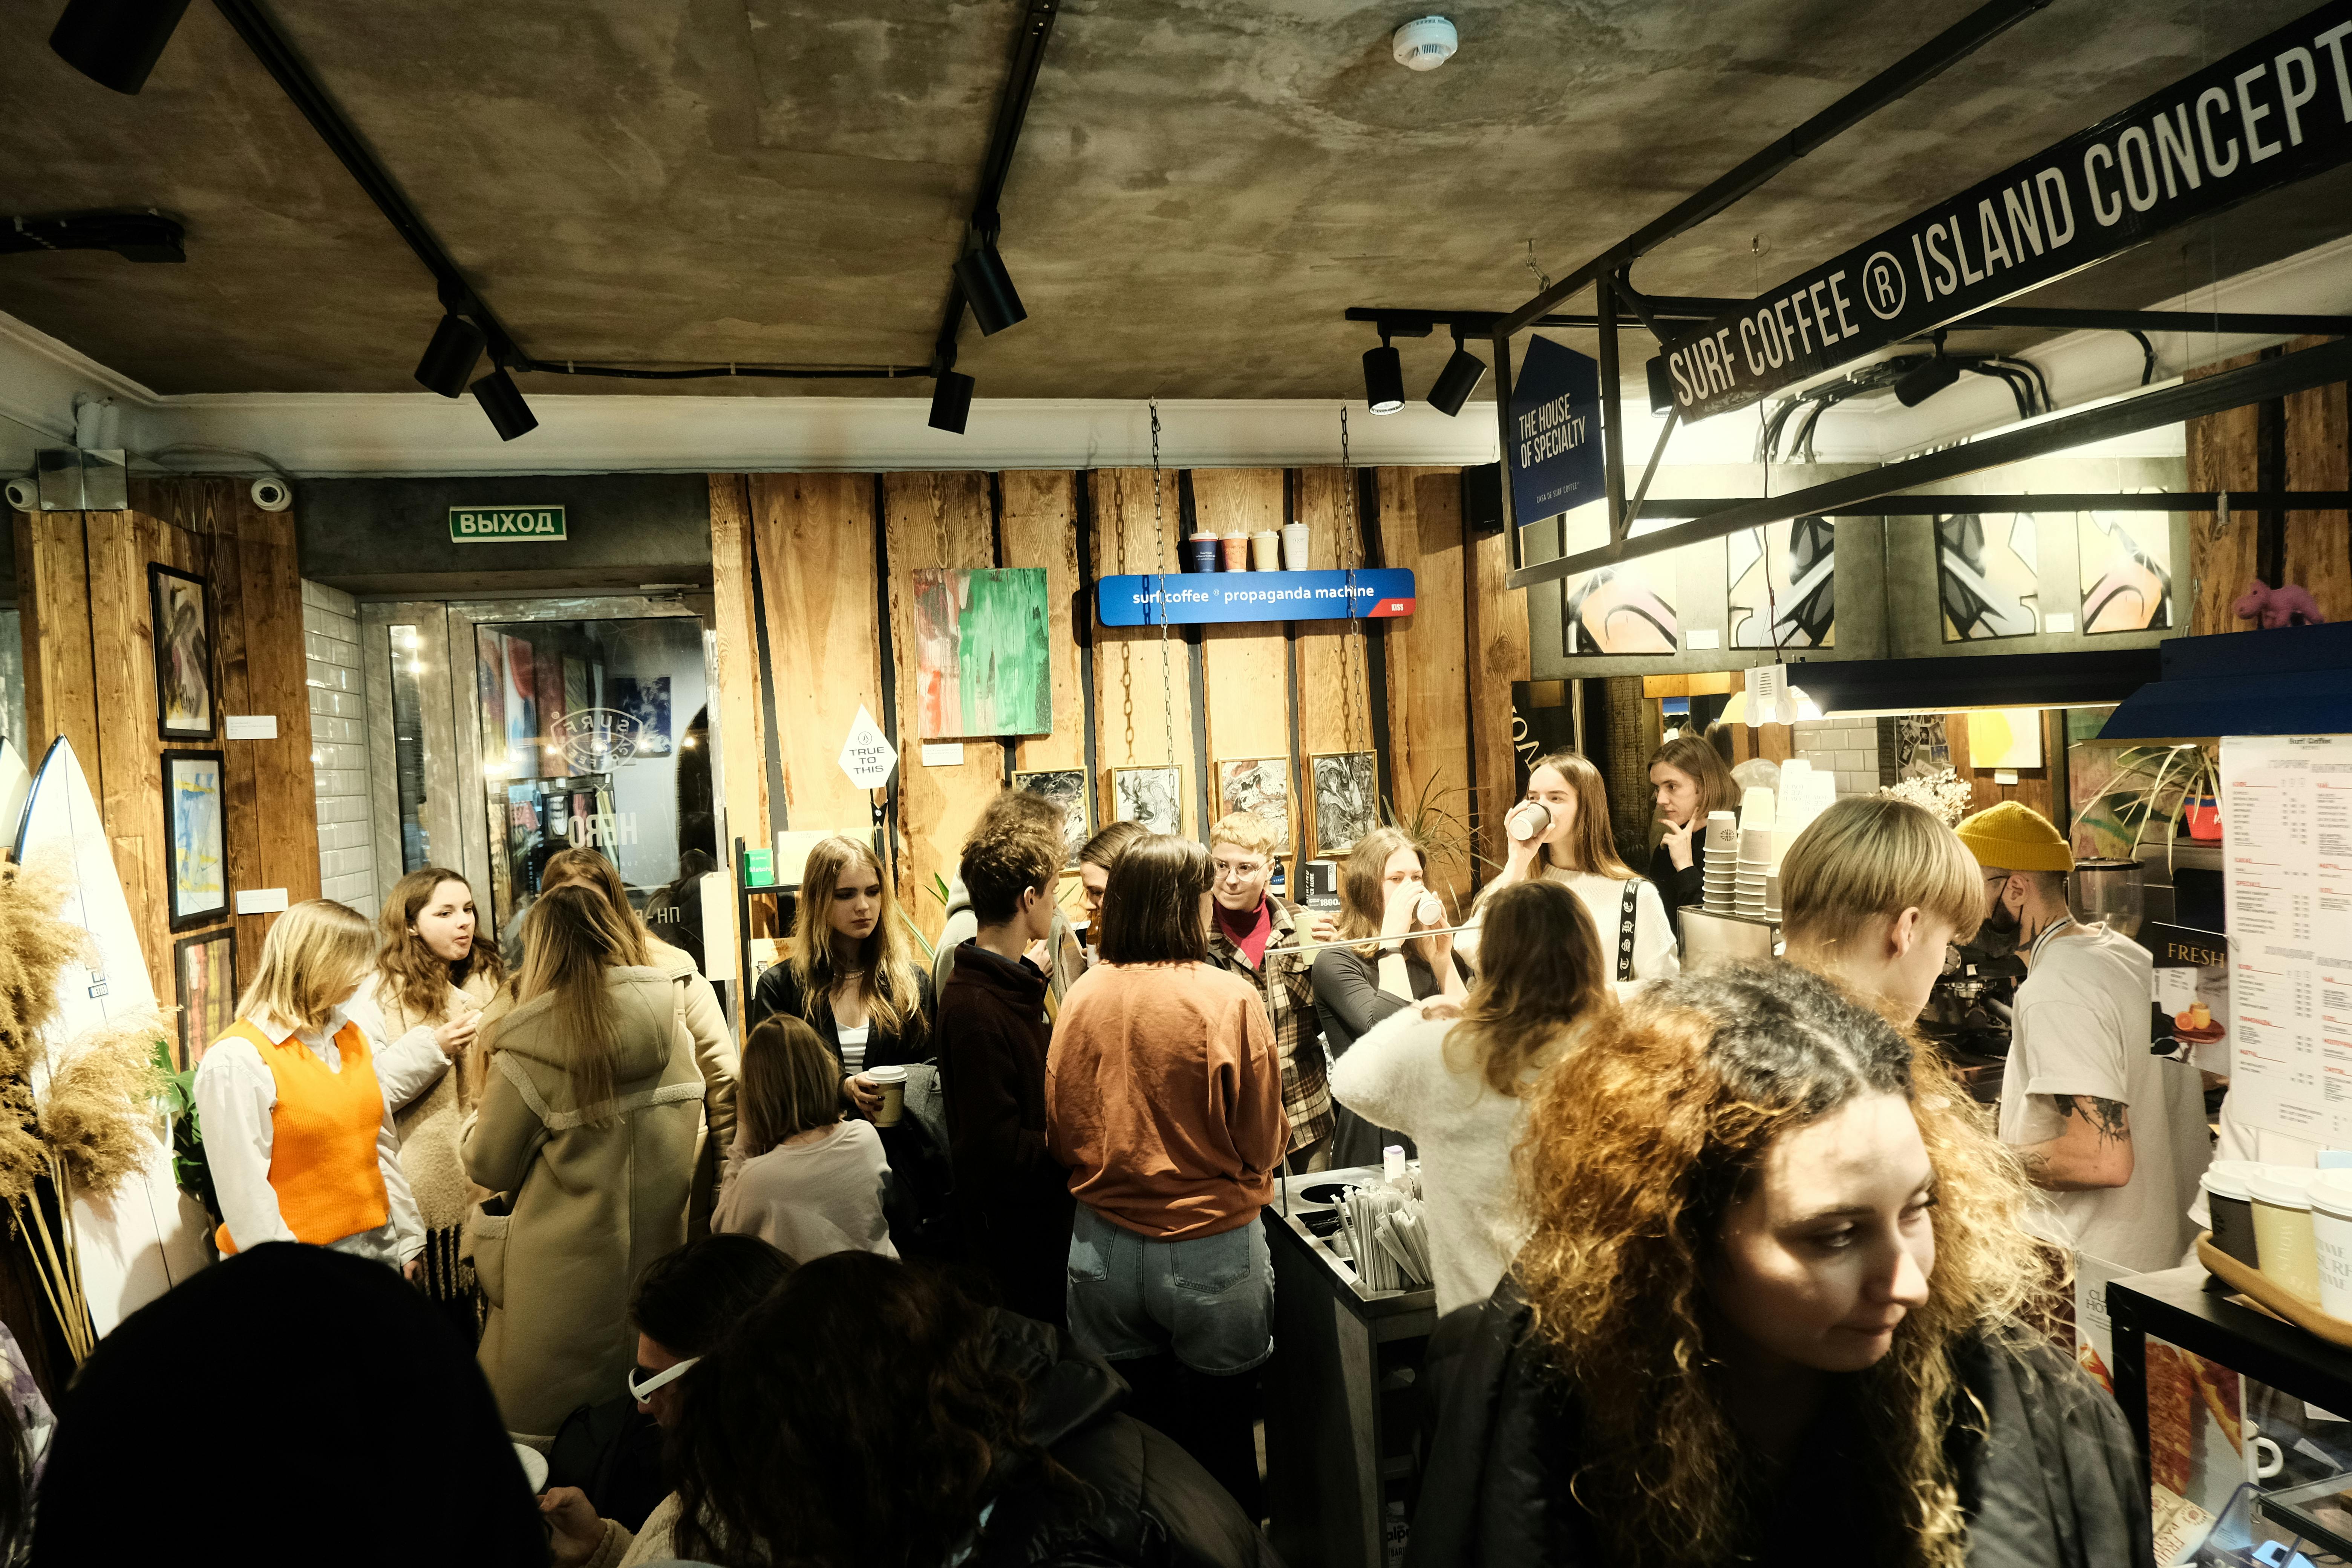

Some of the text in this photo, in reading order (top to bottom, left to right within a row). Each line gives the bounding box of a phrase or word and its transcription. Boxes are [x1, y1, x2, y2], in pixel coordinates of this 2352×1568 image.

[1668, 327, 1738, 408] SURF
[1738, 270, 1860, 377] COFFEE
[1912, 166, 2076, 303] ISLAND
[2084, 20, 2352, 227] CONCEPT
[1519, 392, 1571, 441] THE HOUSE
[1521, 416, 1586, 469] OF SPECIALTY
[1537, 494, 1546, 504] CASA
[1547, 491, 1552, 499] DE
[1553, 487, 1562, 498] SURF
[460, 511, 555, 533] ВЫХОД
[1166, 585, 1209, 603] coffee
[1225, 586, 1311, 605] propaganda
[1315, 585, 1374, 600] machine
[850, 747, 885, 756] TRUE
[853, 765, 884, 775] THIS
[2168, 943, 2225, 969] FRESH
